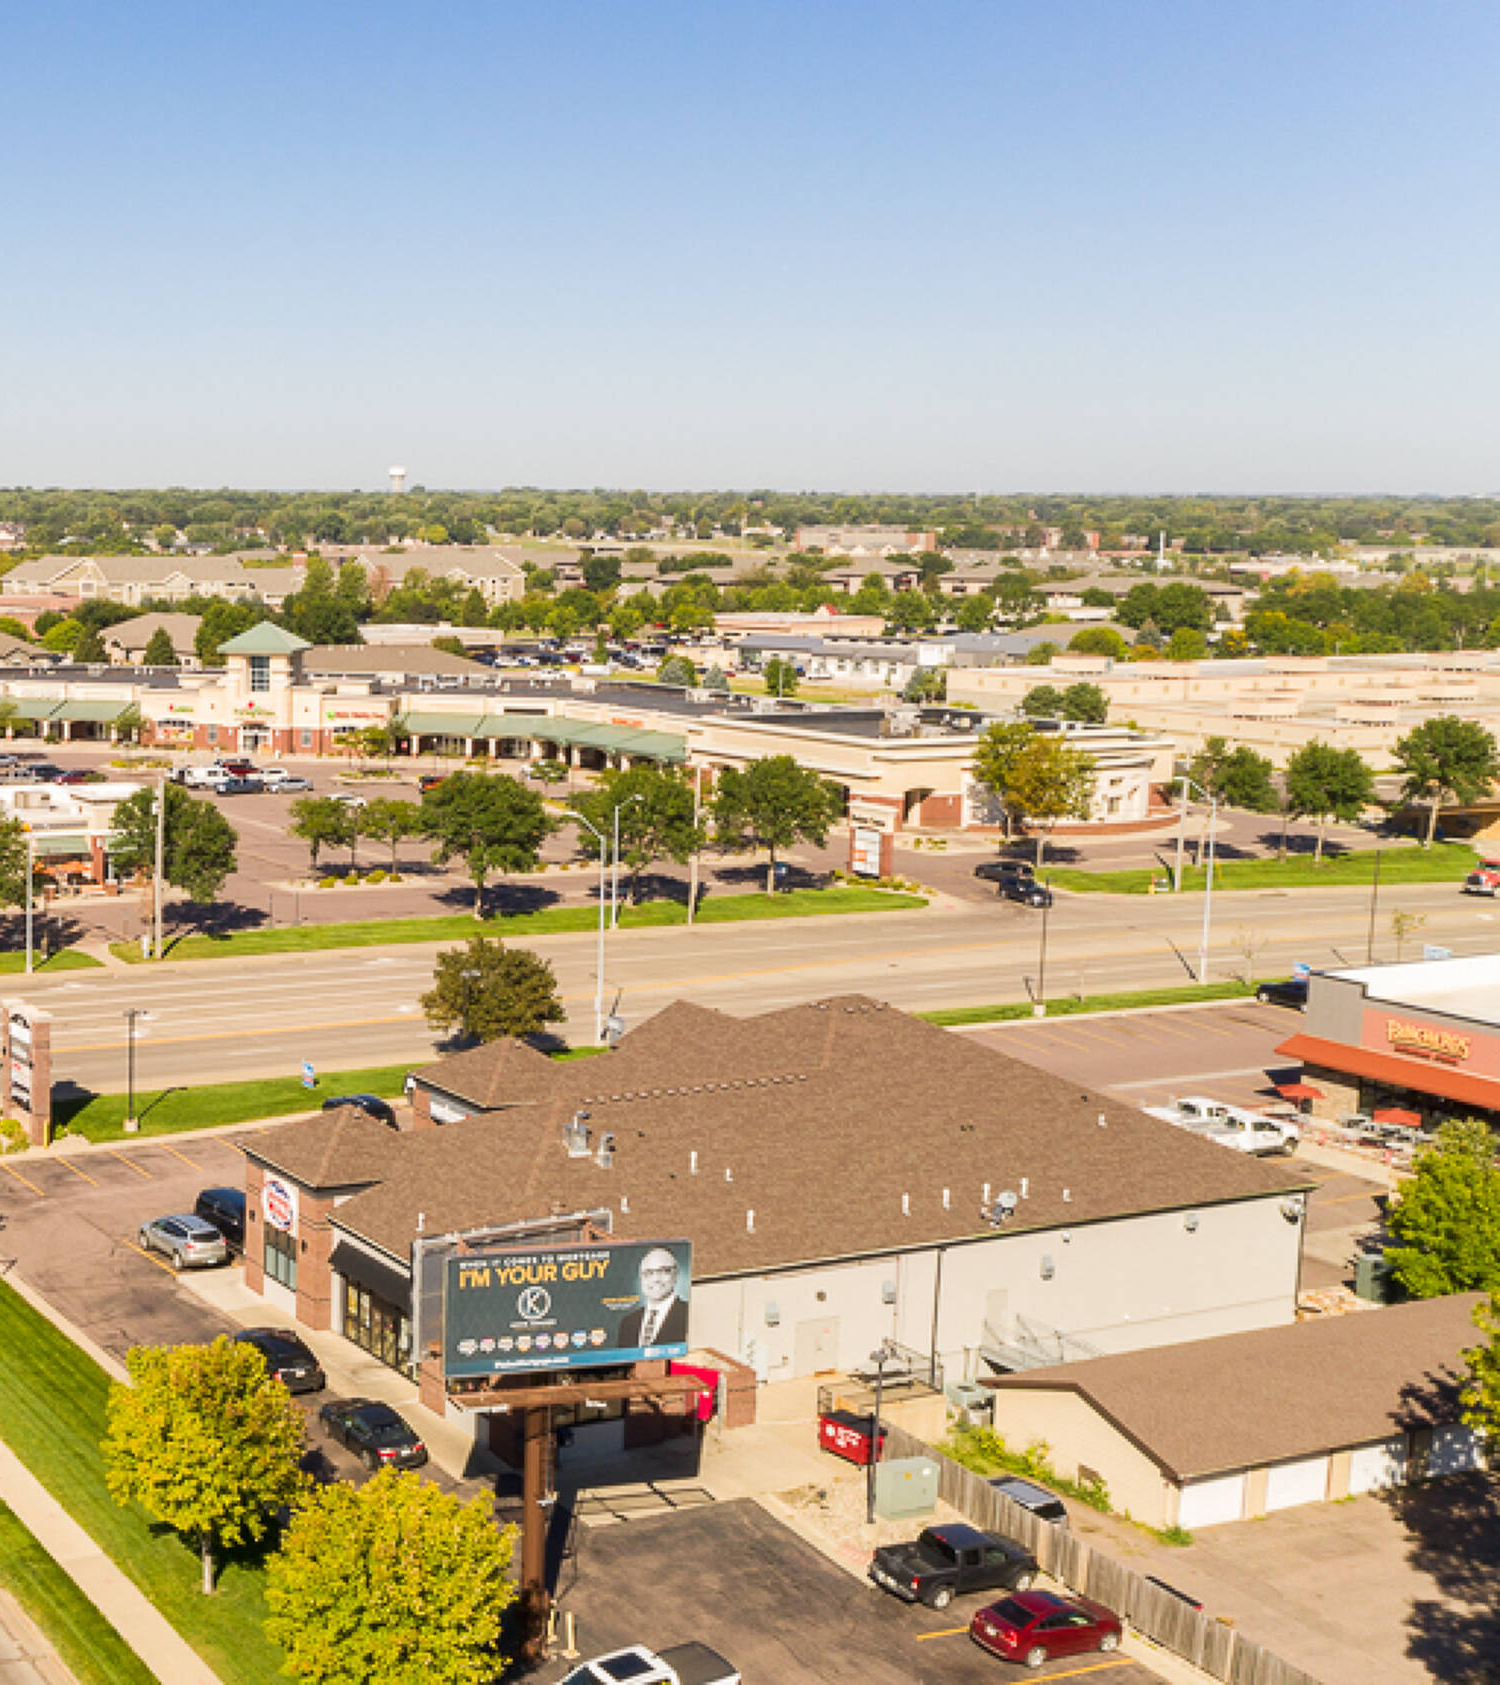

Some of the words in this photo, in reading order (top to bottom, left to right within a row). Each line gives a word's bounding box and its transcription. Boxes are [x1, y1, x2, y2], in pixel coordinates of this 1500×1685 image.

[459, 1260, 487, 1270] WHEN
[503, 1256, 537, 1266] COMES
[459, 1268, 491, 1289] I'M
[495, 1263, 557, 1285] YOUR
[562, 1259, 610, 1281] GUY
